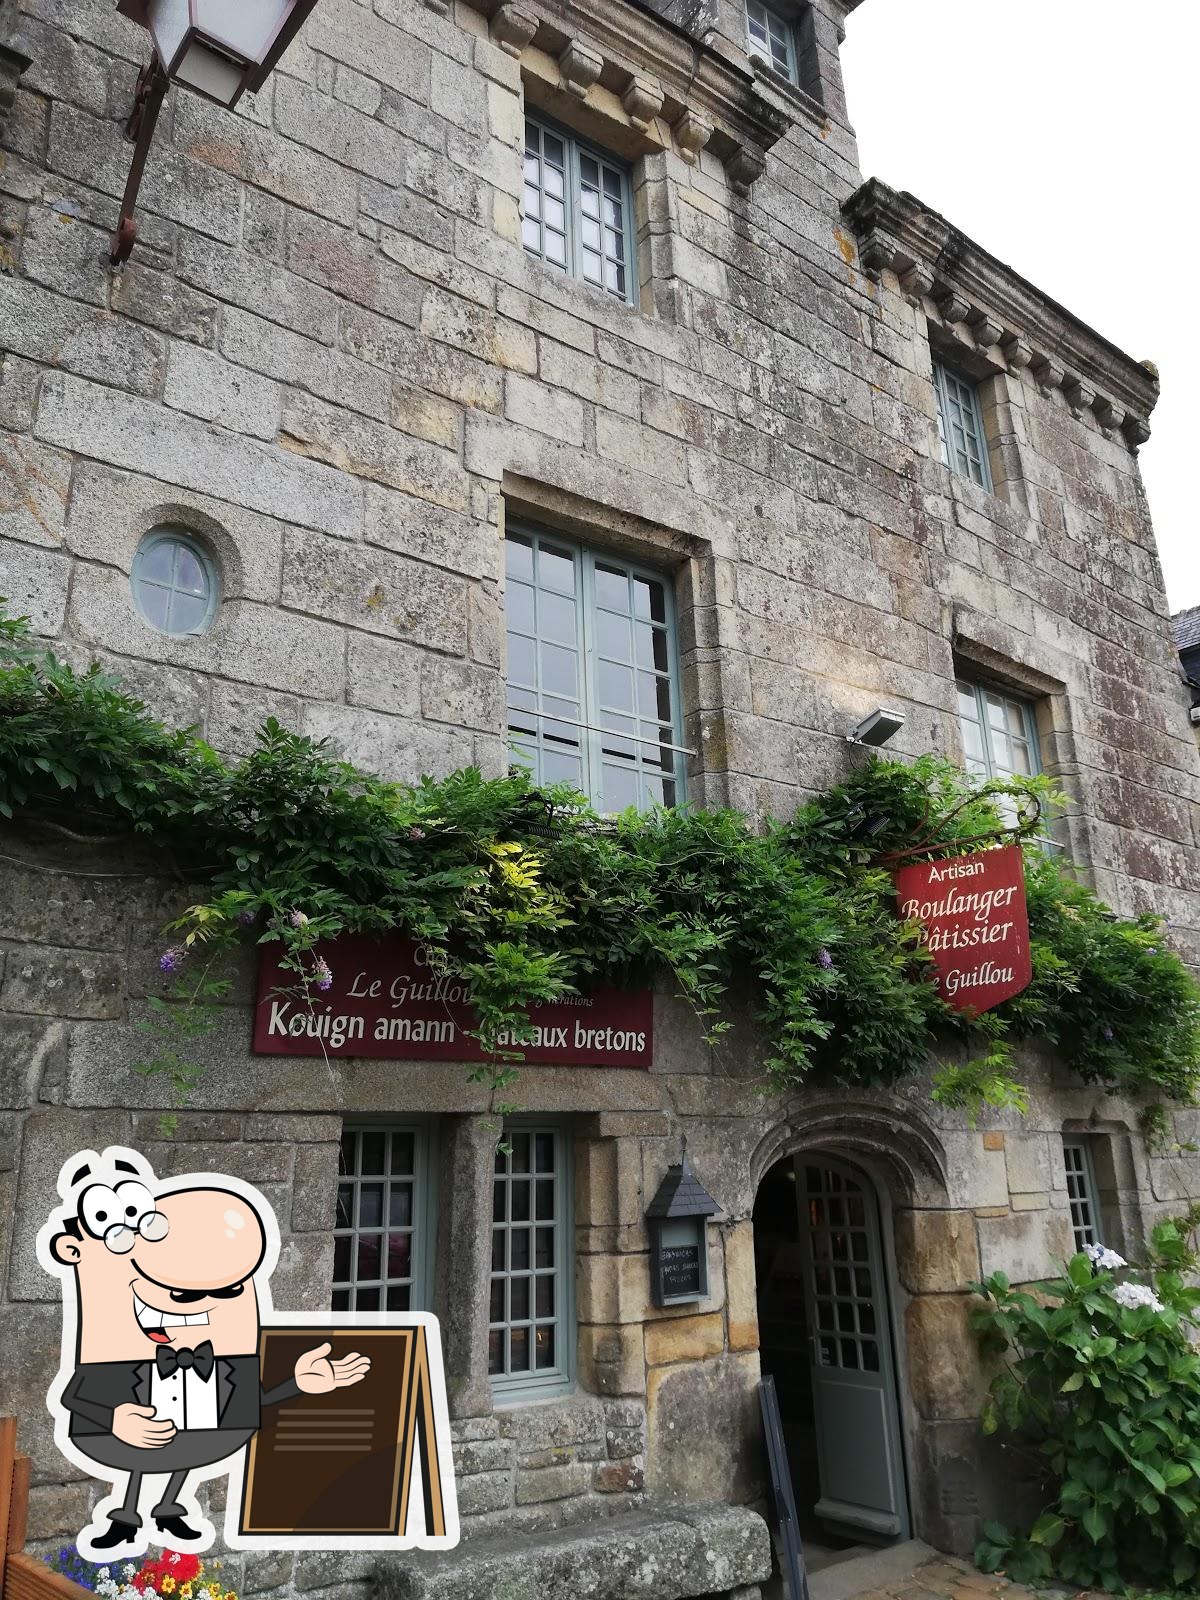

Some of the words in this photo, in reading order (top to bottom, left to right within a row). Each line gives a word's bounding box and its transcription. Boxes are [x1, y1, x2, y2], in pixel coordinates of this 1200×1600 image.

[928, 862, 985, 883] Artisan
[902, 886, 1017, 922] Boulanger
[346, 972, 383, 998] Le
[946, 961, 1014, 997] Guillou
[535, 995, 594, 1008] rations
[268, 1001, 365, 1049] Kouign
[374, 1017, 455, 1043] amann
[574, 1019, 646, 1053] bretons
